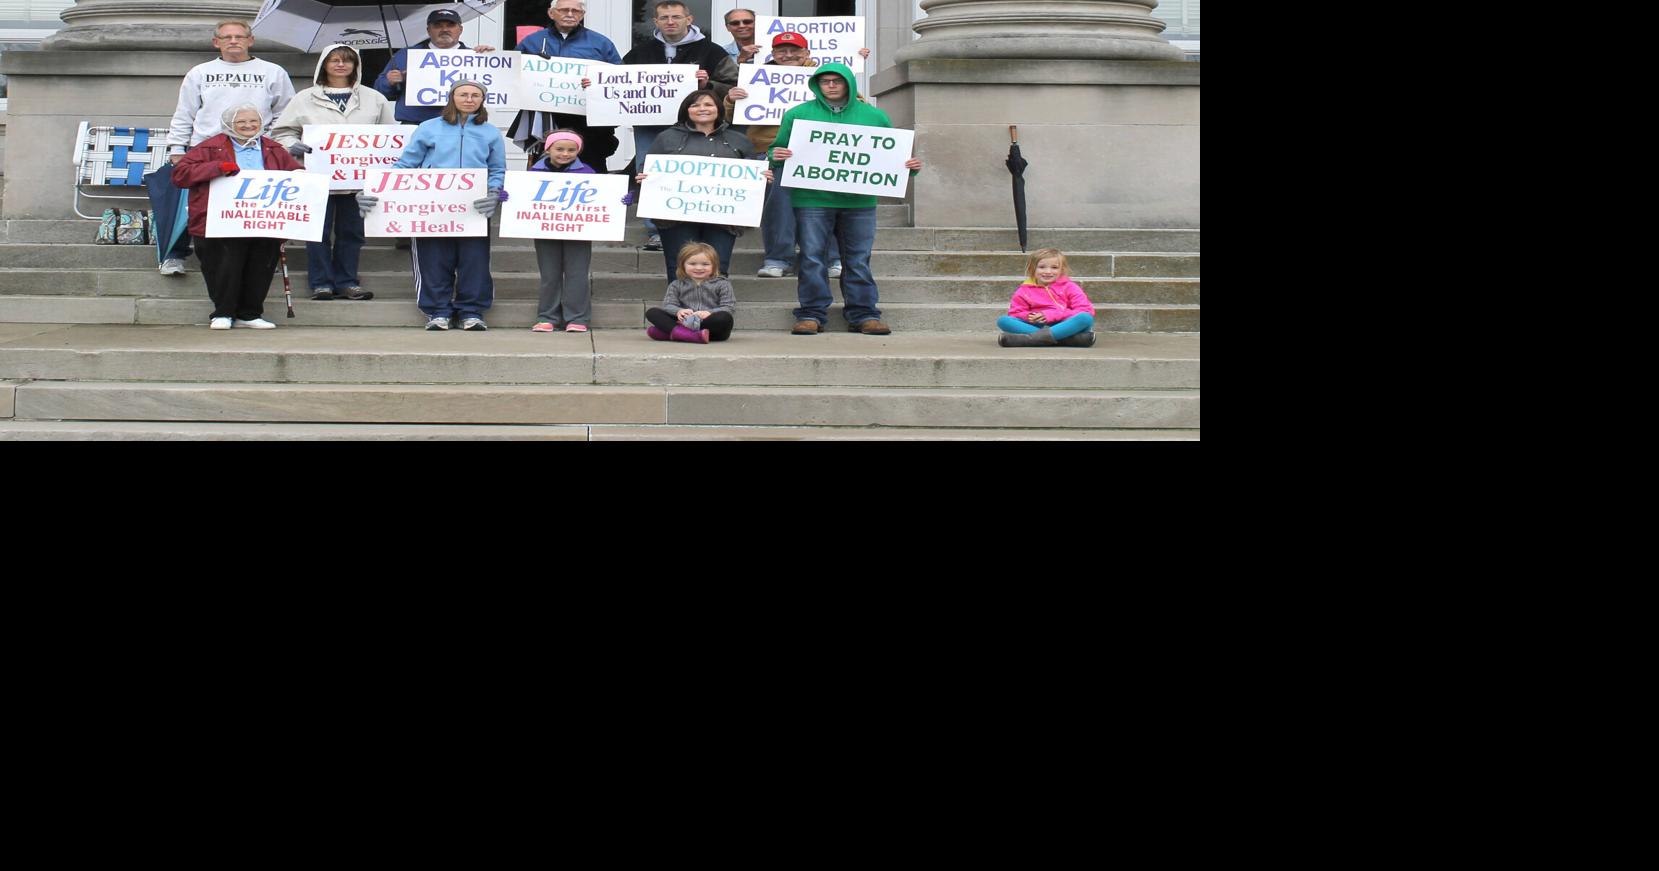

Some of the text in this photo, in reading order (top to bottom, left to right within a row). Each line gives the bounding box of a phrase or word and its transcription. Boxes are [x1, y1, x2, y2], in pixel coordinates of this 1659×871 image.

[766, 19, 856, 35] ABORTION
[419, 51, 512, 69] ABORTION
[522, 59, 585, 76] ADOPT
[206, 73, 265, 83] DEPAUW
[549, 77, 582, 90] Lov
[597, 71, 685, 86] Lord, Forgive
[749, 68, 815, 86] ABOR
[416, 87, 508, 105] CHEN
[539, 91, 586, 107] Optio
[603, 86, 678, 99] Us and Our
[768, 87, 815, 104] KILL
[619, 101, 662, 114] Nation
[319, 132, 404, 151] JESUS
[809, 130, 896, 150] PRAY TO
[330, 153, 400, 167] Forgives
[828, 150, 871, 166] END
[331, 169, 347, 181] &
[371, 171, 476, 193] JESUS
[792, 165, 898, 187] ABORTION
[233, 177, 300, 208] Life
[531, 180, 598, 211] Life
[676, 180, 748, 201] Loving
[278, 201, 308, 211] first
[383, 201, 467, 215] Forgives
[575, 204, 608, 212] first
[665, 196, 735, 215] Option
[220, 210, 310, 222] INALIENABLE
[516, 211, 610, 223] INALIENABLE
[243, 220, 286, 230] RIGHT
[385, 220, 465, 233] & Heals
[541, 222, 585, 232] RIGHT
